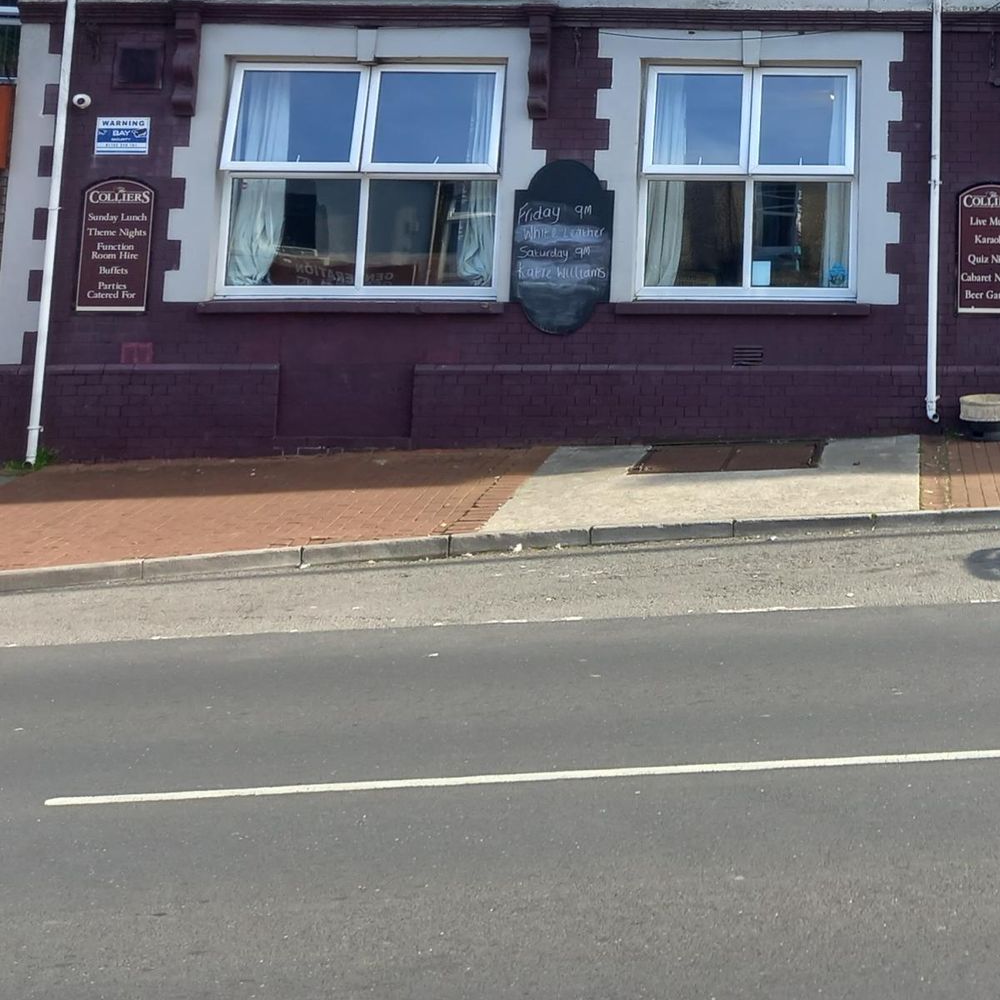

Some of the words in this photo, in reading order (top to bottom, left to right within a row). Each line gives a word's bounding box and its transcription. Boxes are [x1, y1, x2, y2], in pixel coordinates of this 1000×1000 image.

[88, 212, 119, 224] Sunday
[121, 212, 147, 221] Lunch
[518, 202, 561, 224] Friday
[970, 216, 987, 226] Live
[87, 227, 116, 237] Theme
[119, 228, 147, 239] Nights
[97, 242, 134, 251] Function
[91, 251, 116, 260] Room
[119, 251, 139, 260] Hire
[518, 245, 569, 263] Saturday
[967, 254, 989, 265] Quiz
[99, 266, 128, 275] Buffets
[960, 272, 992, 282] Cabaret
[98, 282, 127, 290] Parties
[87, 290, 118, 299] Catered
[121, 290, 136, 299] For
[965, 289, 984, 300] Beer
